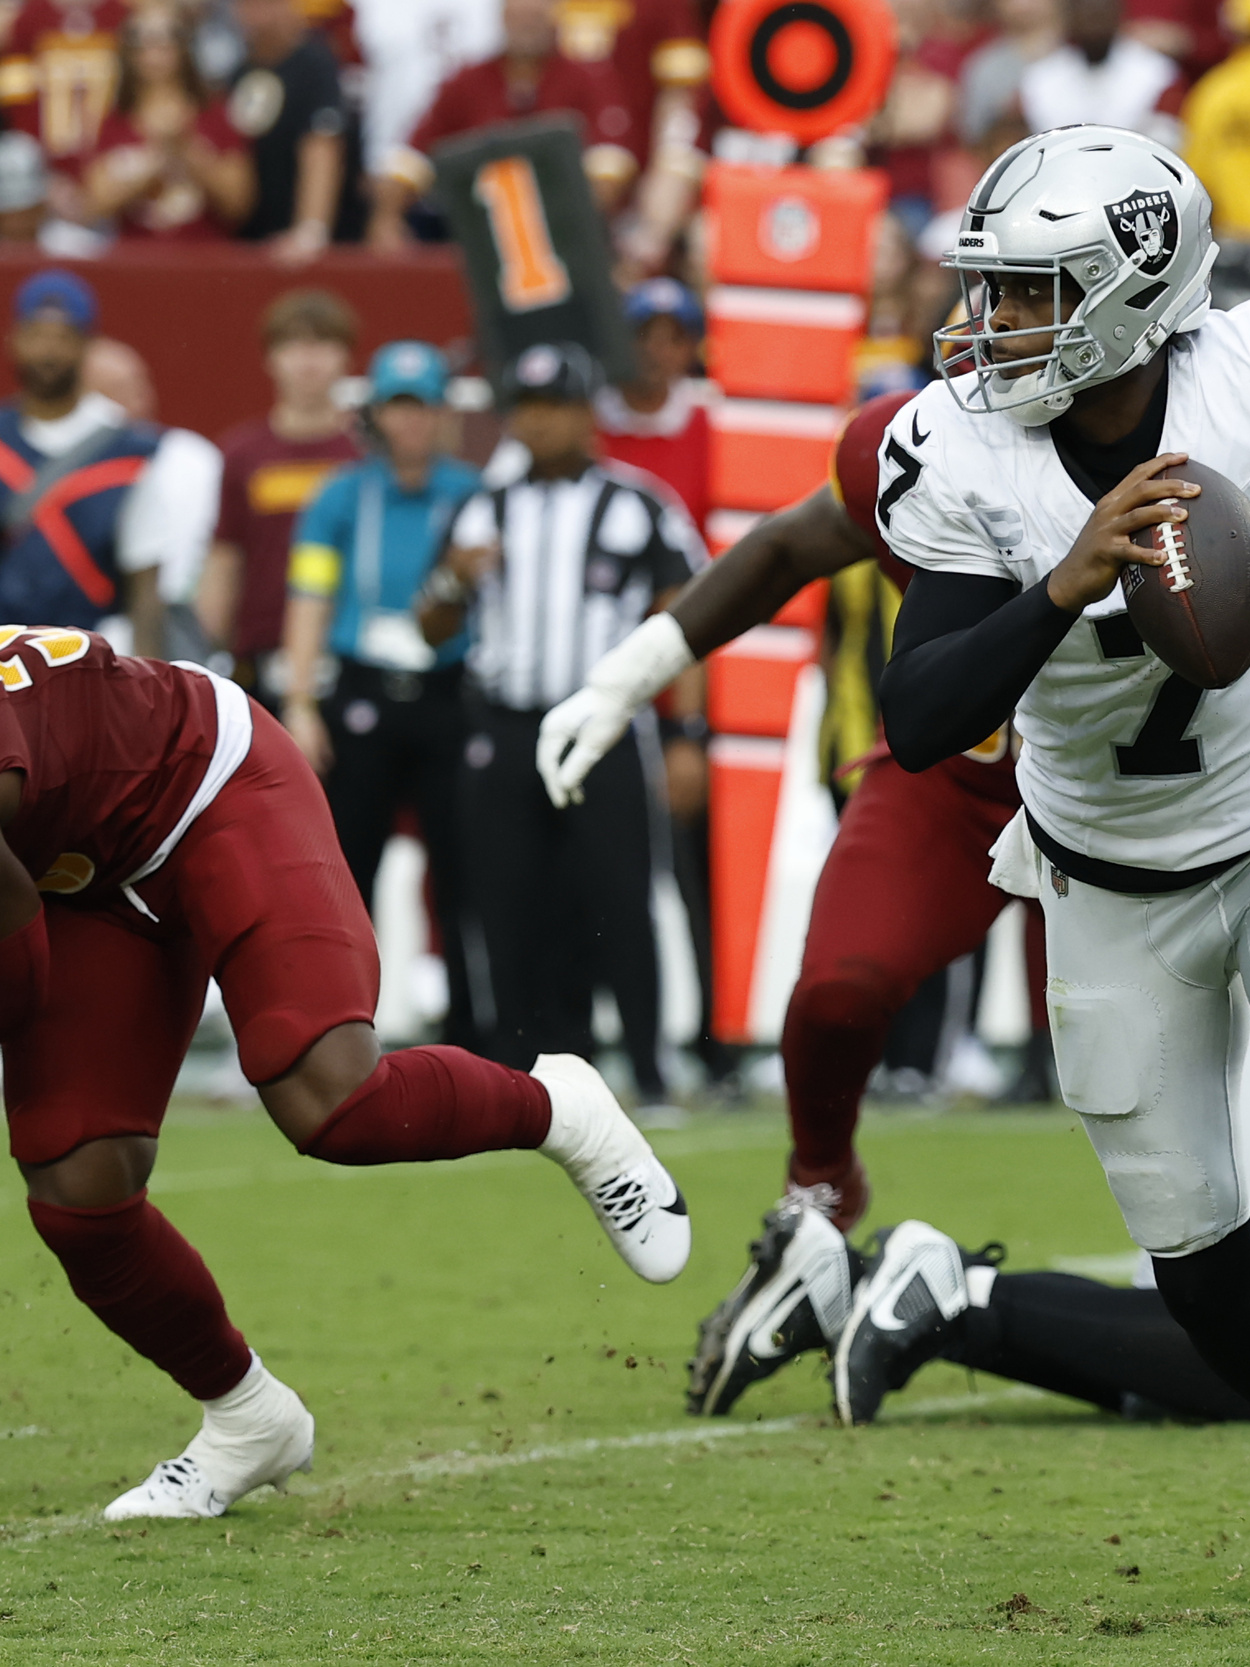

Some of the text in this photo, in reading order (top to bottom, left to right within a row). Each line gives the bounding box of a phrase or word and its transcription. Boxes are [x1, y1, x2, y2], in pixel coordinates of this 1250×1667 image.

[473, 154, 573, 315] 1
[1112, 193, 1168, 216] RAIDERS
[877, 434, 927, 533] 7
[1089, 608, 1207, 780] 7
